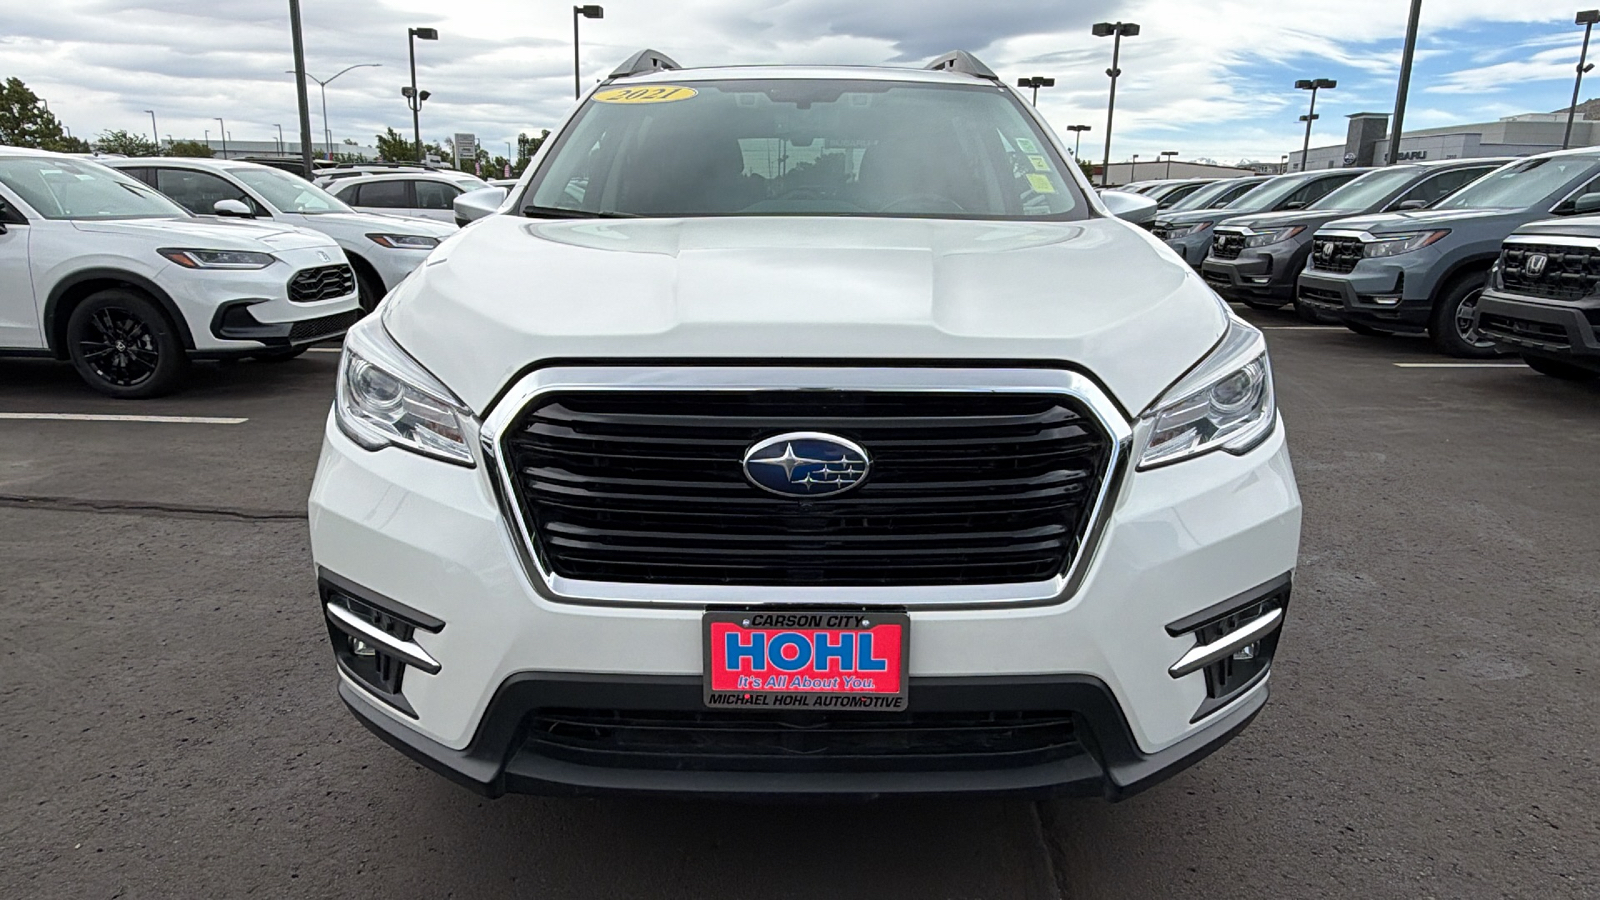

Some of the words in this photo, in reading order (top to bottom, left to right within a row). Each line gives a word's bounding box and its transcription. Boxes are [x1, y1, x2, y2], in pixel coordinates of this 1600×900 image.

[606, 88, 682, 100] 2021
[752, 614, 823, 628] CARSON
[827, 615, 865, 628] CITY
[725, 632, 888, 672] HOHL
[738, 675, 761, 688] It's
[765, 675, 788, 688] All
[790, 675, 840, 689] About
[842, 675, 875, 689] You.
[709, 693, 769, 706] MICHAEL
[773, 695, 810, 707] HOHL
[813, 696, 903, 708] AUTOMOTIVE
